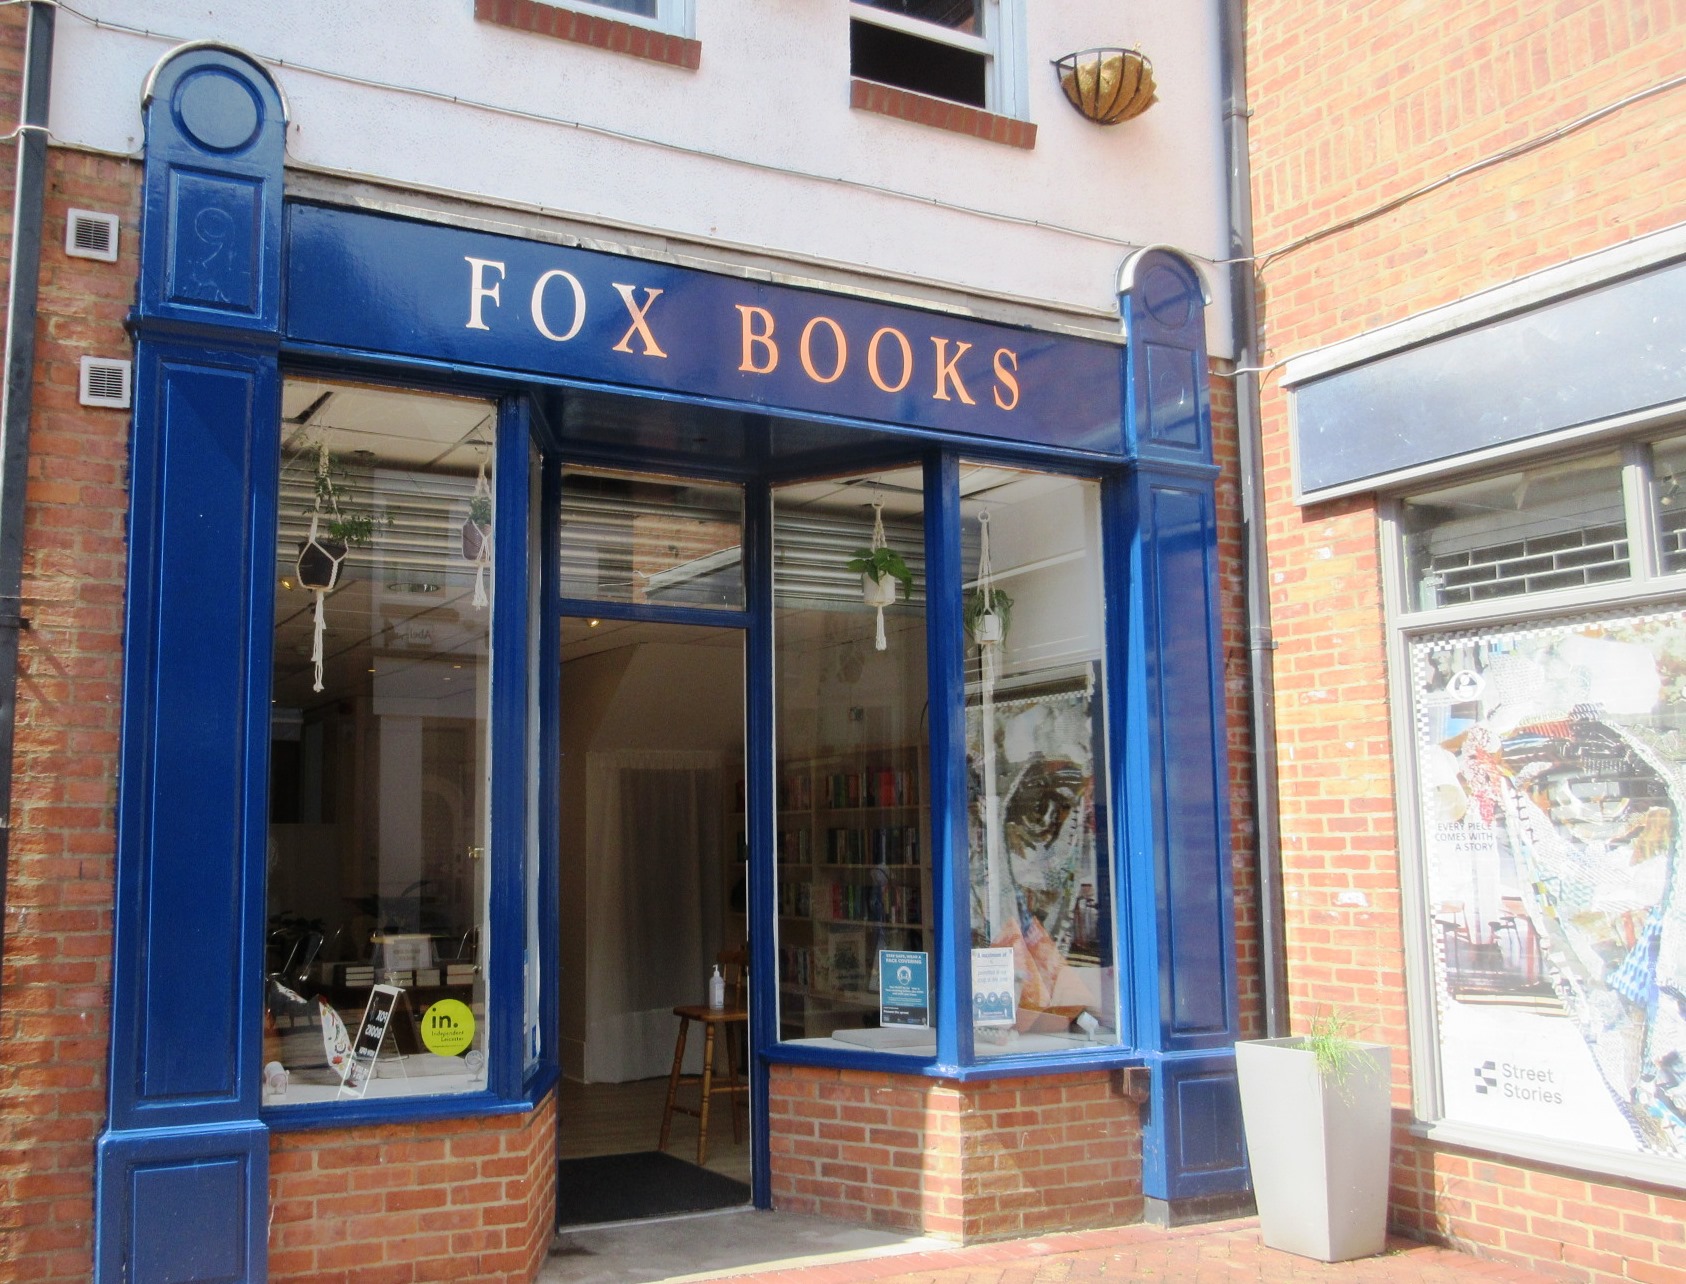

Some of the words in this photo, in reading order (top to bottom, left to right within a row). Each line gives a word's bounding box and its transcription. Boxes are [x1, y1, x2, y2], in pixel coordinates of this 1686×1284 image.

[464, 256, 667, 358] FOX
[735, 304, 1019, 411] BOOKS
[1437, 822, 1465, 831] EVERY
[1468, 822, 1492, 831] PIECE
[1435, 833, 1466, 841] COMES
[1469, 833, 1493, 841] WITH
[1456, 843, 1462, 851] A
[1464, 843, 1493, 851] STORY
[432, 1007, 459, 1028] in.
[1502, 1063, 1554, 1083] Street
[1504, 1082, 1562, 1104] Stories
